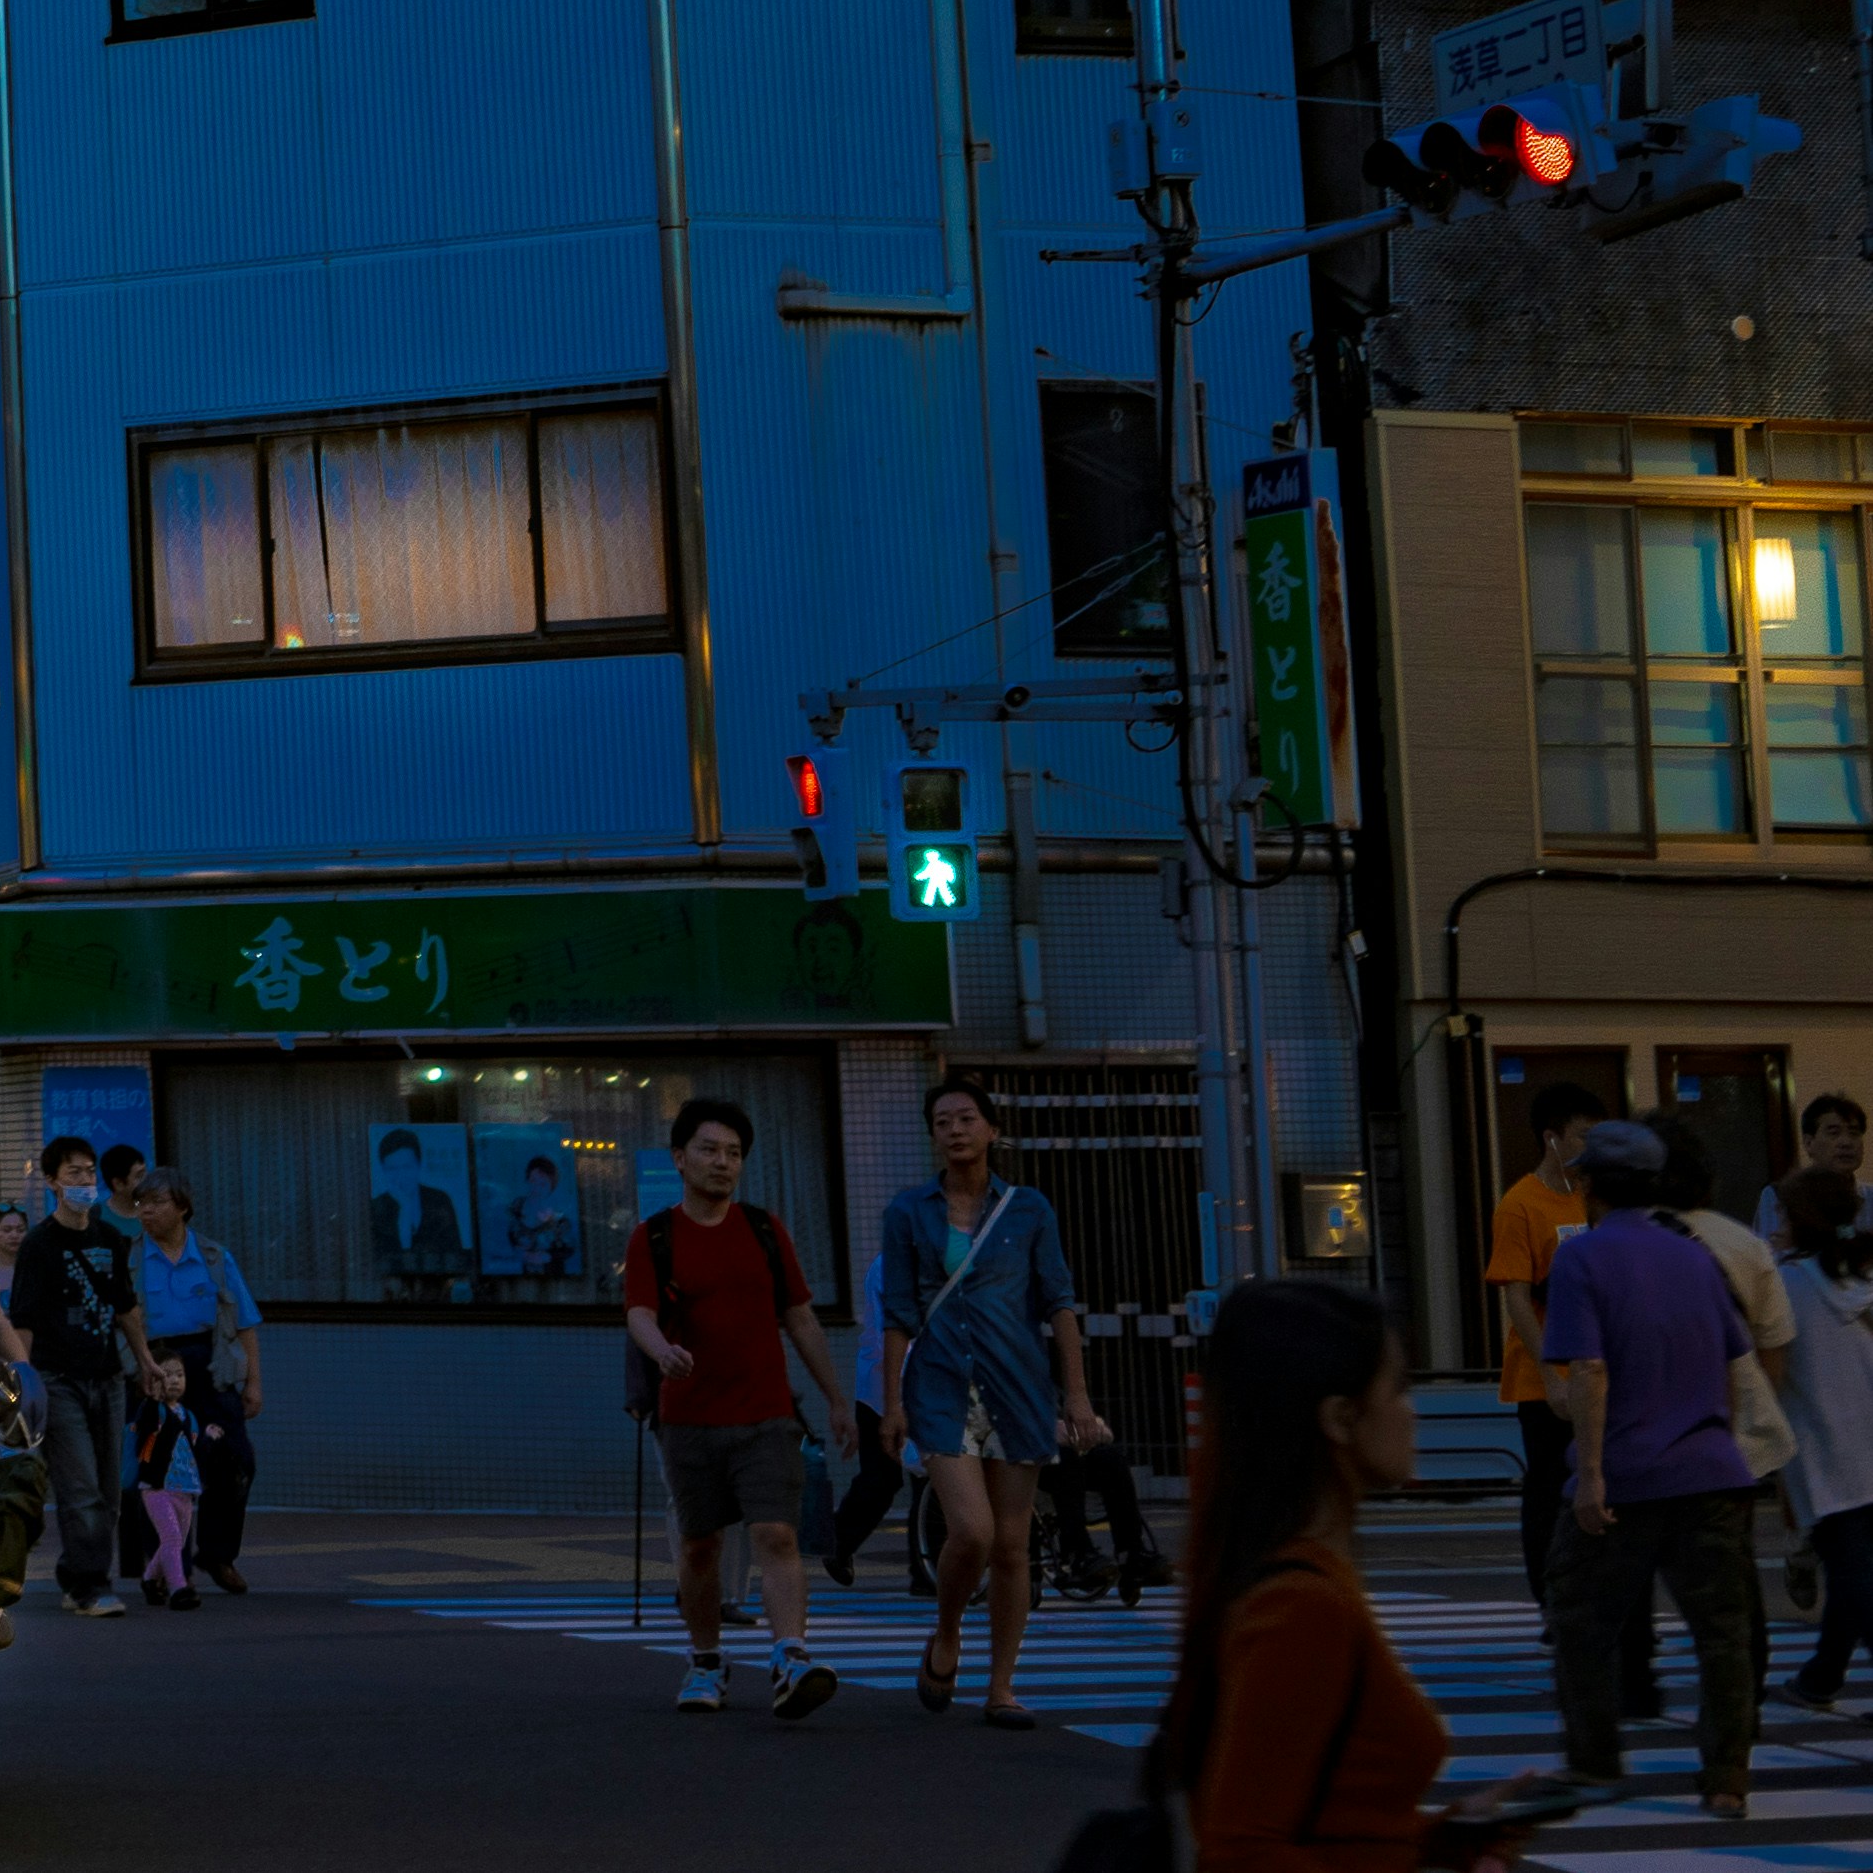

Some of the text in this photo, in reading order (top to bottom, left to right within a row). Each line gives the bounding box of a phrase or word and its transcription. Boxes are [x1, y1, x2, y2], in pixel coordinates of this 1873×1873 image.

[1448, 6, 1587, 97] 浅草二丁目
[1247, 465, 1301, 512] Asahi
[1256, 540, 1303, 797] 香とり
[233, 915, 449, 1015] 香とり
[51, 1089, 146, 1110] 教育負担の
